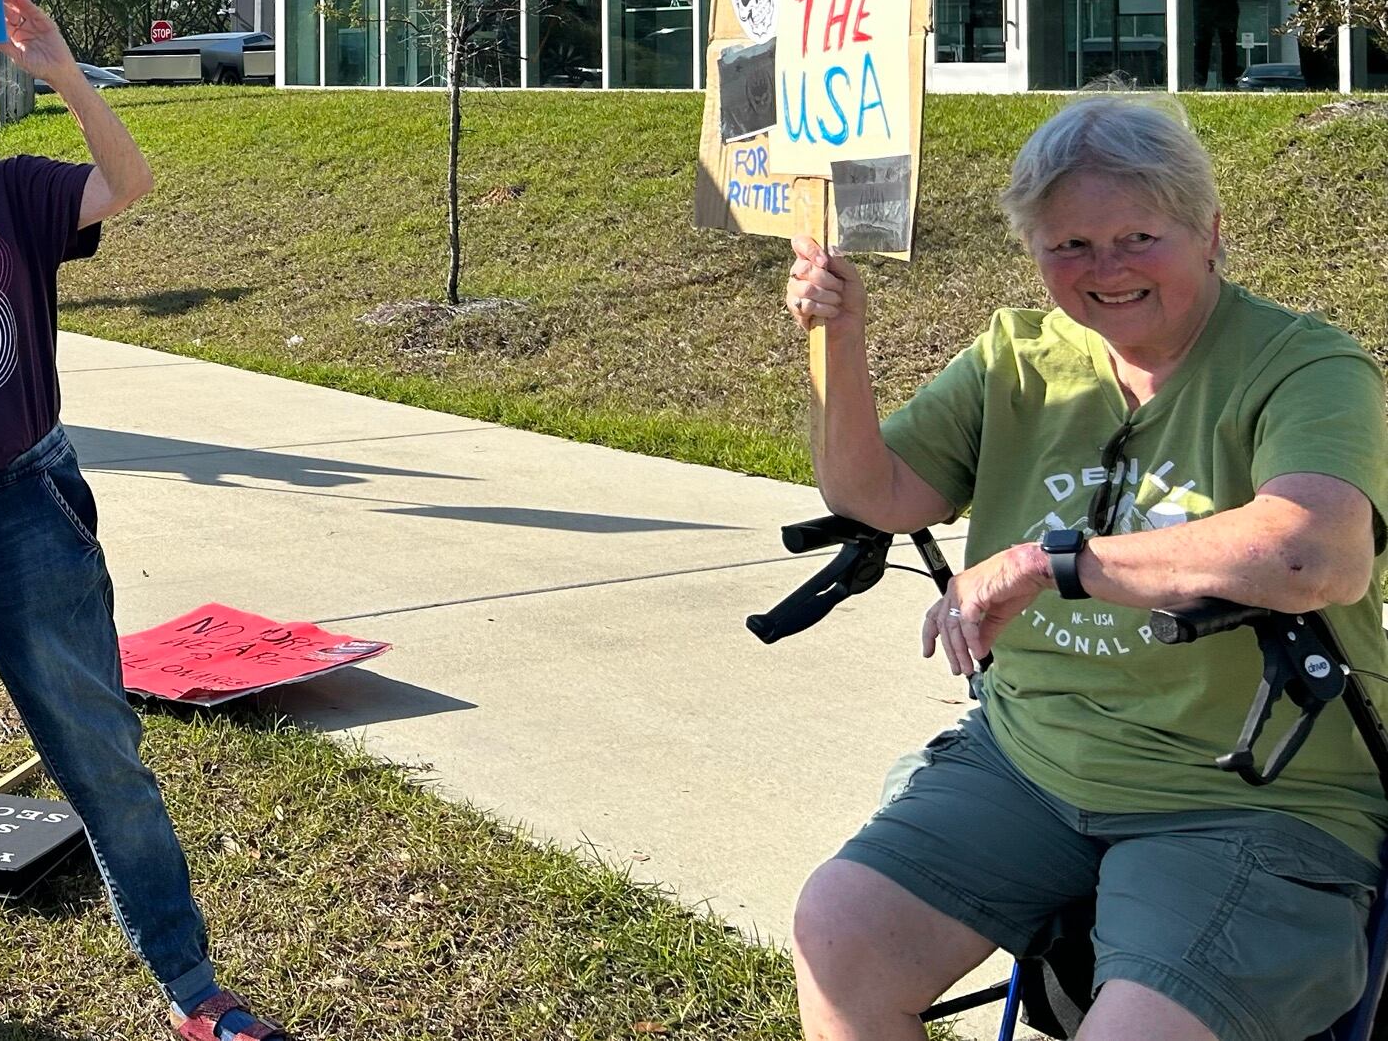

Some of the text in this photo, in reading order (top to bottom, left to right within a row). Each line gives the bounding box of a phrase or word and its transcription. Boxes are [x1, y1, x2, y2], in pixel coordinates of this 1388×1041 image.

[153, 29, 170, 38] STOP
[782, 51, 891, 146] USA
[735, 146, 768, 178] FOR
[728, 180, 791, 215] RUTHIE
[1044, 458, 1196, 502] DENLI
[176, 616, 244, 637] NO
[1022, 610, 1130, 656] TIONAL
